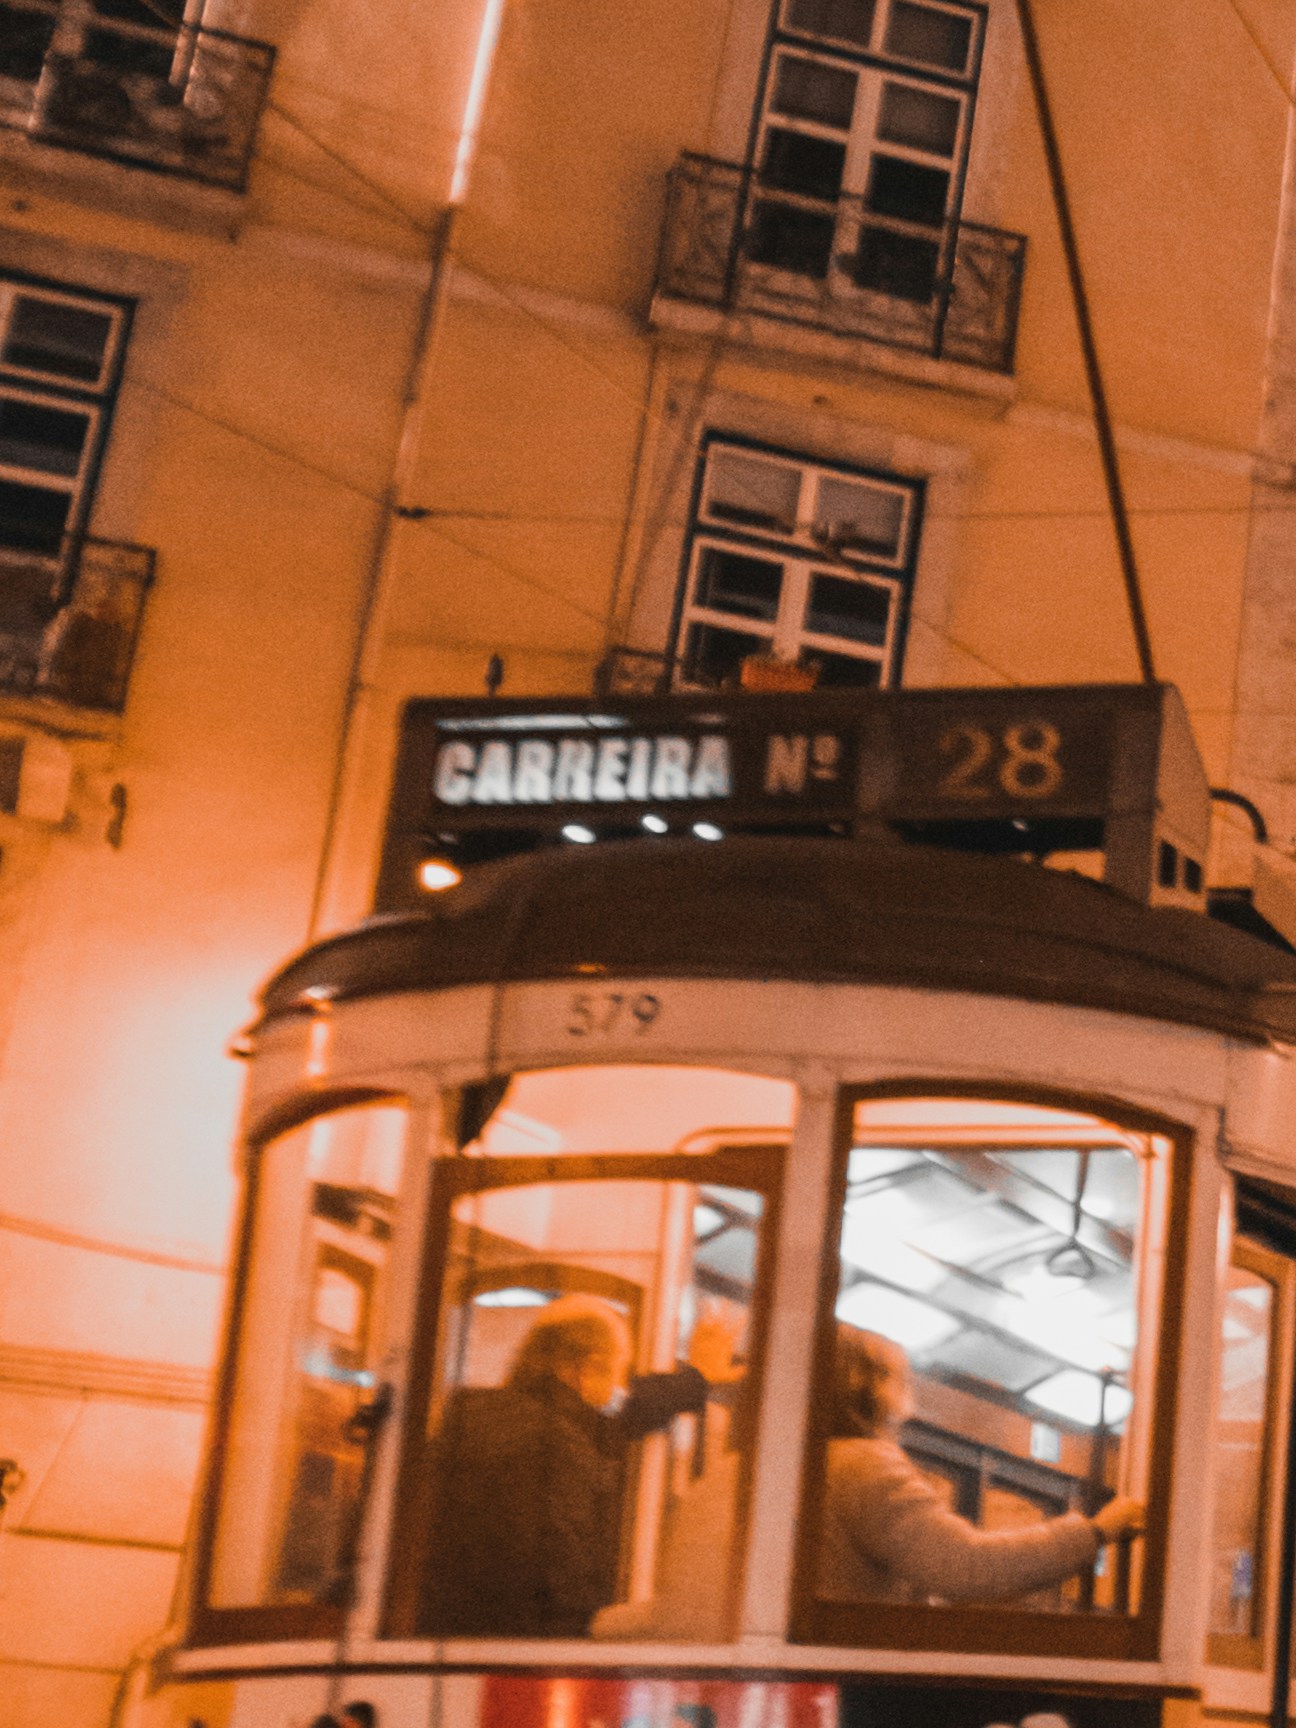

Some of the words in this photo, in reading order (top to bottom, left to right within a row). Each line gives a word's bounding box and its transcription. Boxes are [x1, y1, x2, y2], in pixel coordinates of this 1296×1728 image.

[435, 733, 732, 804] CARREIRA
[936, 721, 1064, 799] 28
[566, 991, 662, 1037] 579
